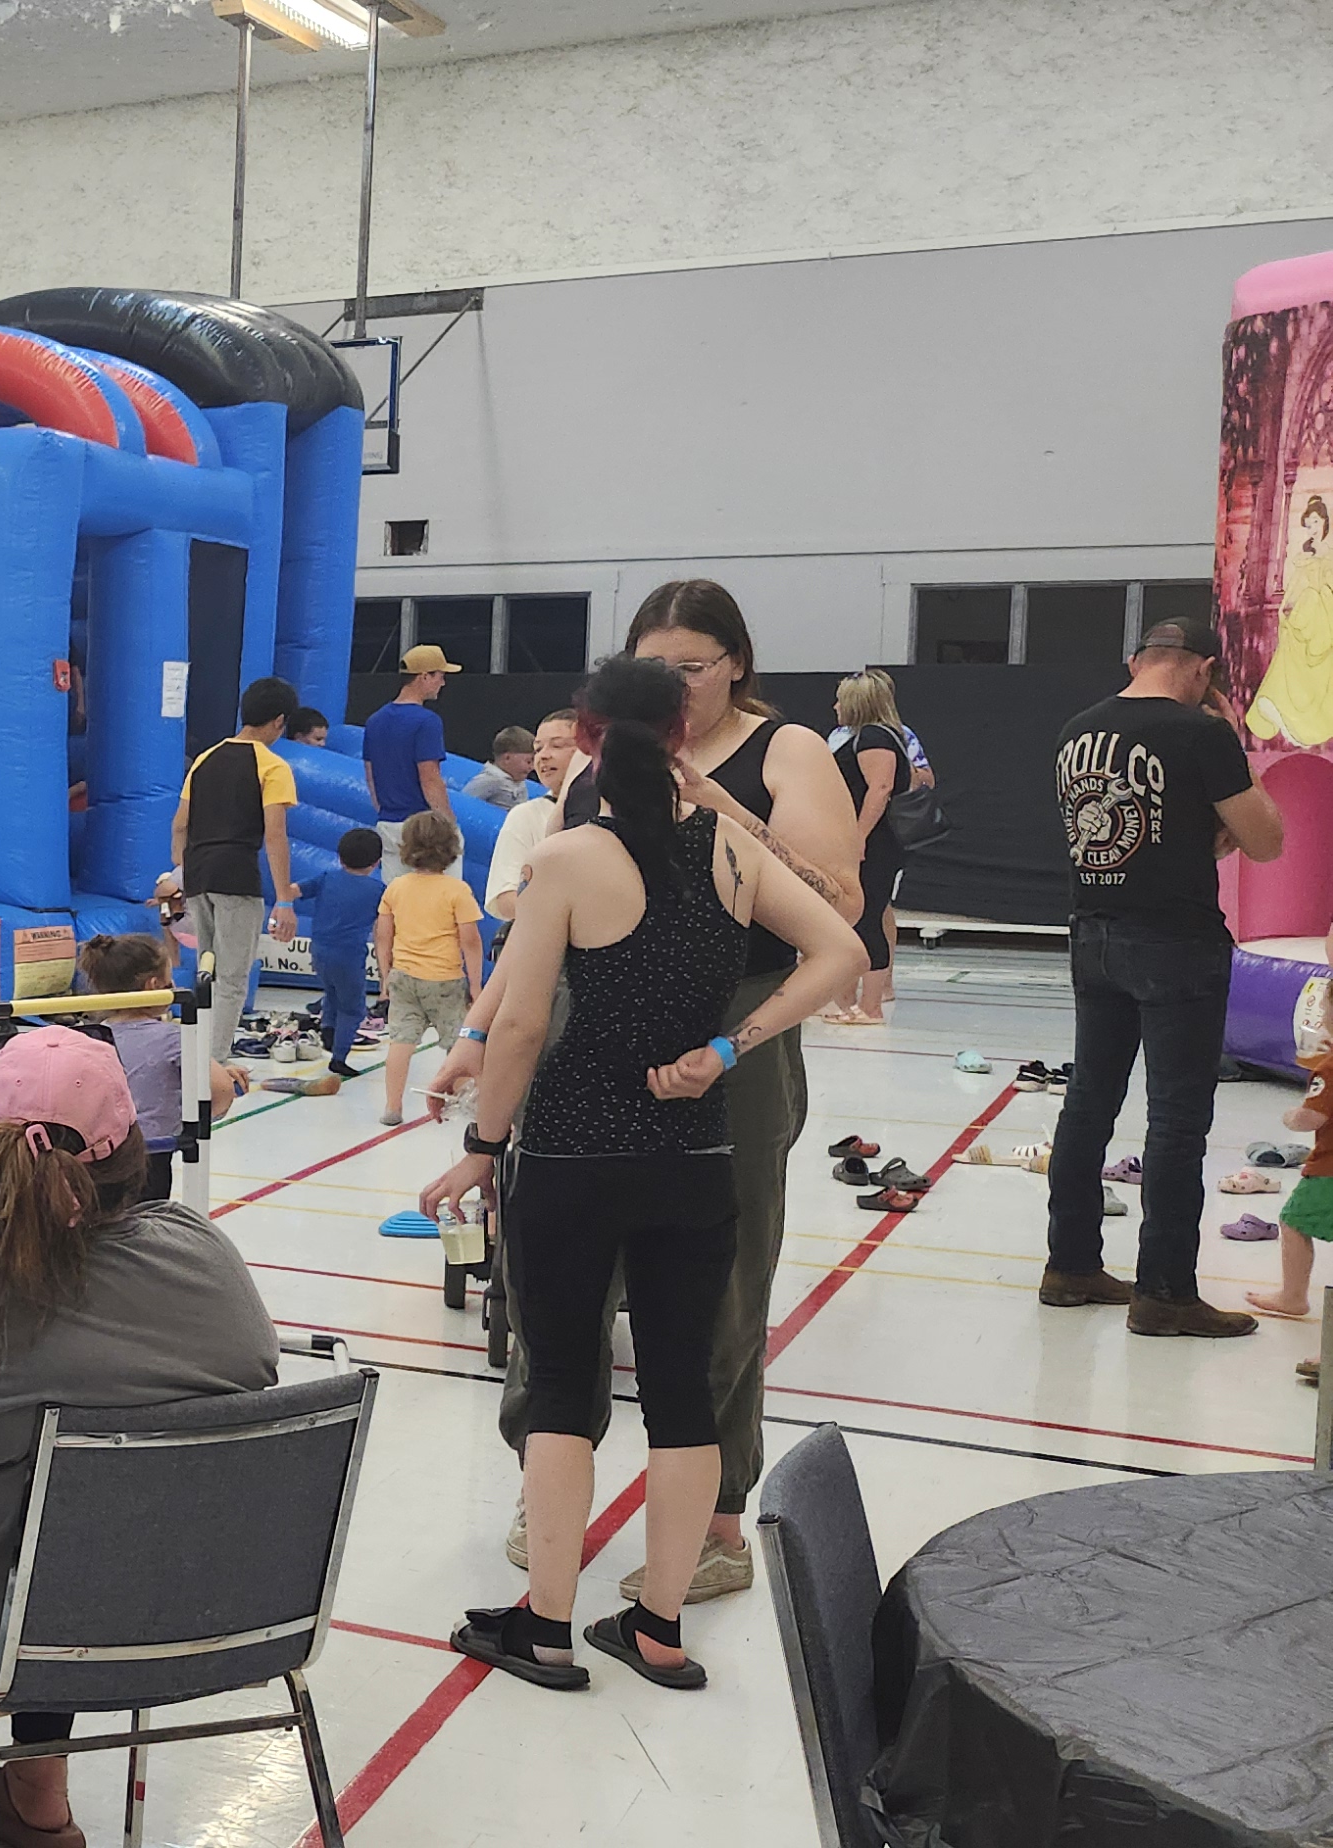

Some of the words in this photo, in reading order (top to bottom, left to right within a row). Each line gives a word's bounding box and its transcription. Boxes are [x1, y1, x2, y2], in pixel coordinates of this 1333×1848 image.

[1087, 844, 1123, 865] CLEAN
[1116, 804, 1139, 850] MONEY
[1098, 872, 1126, 885] 2017
[278, 958, 304, 971] No.
